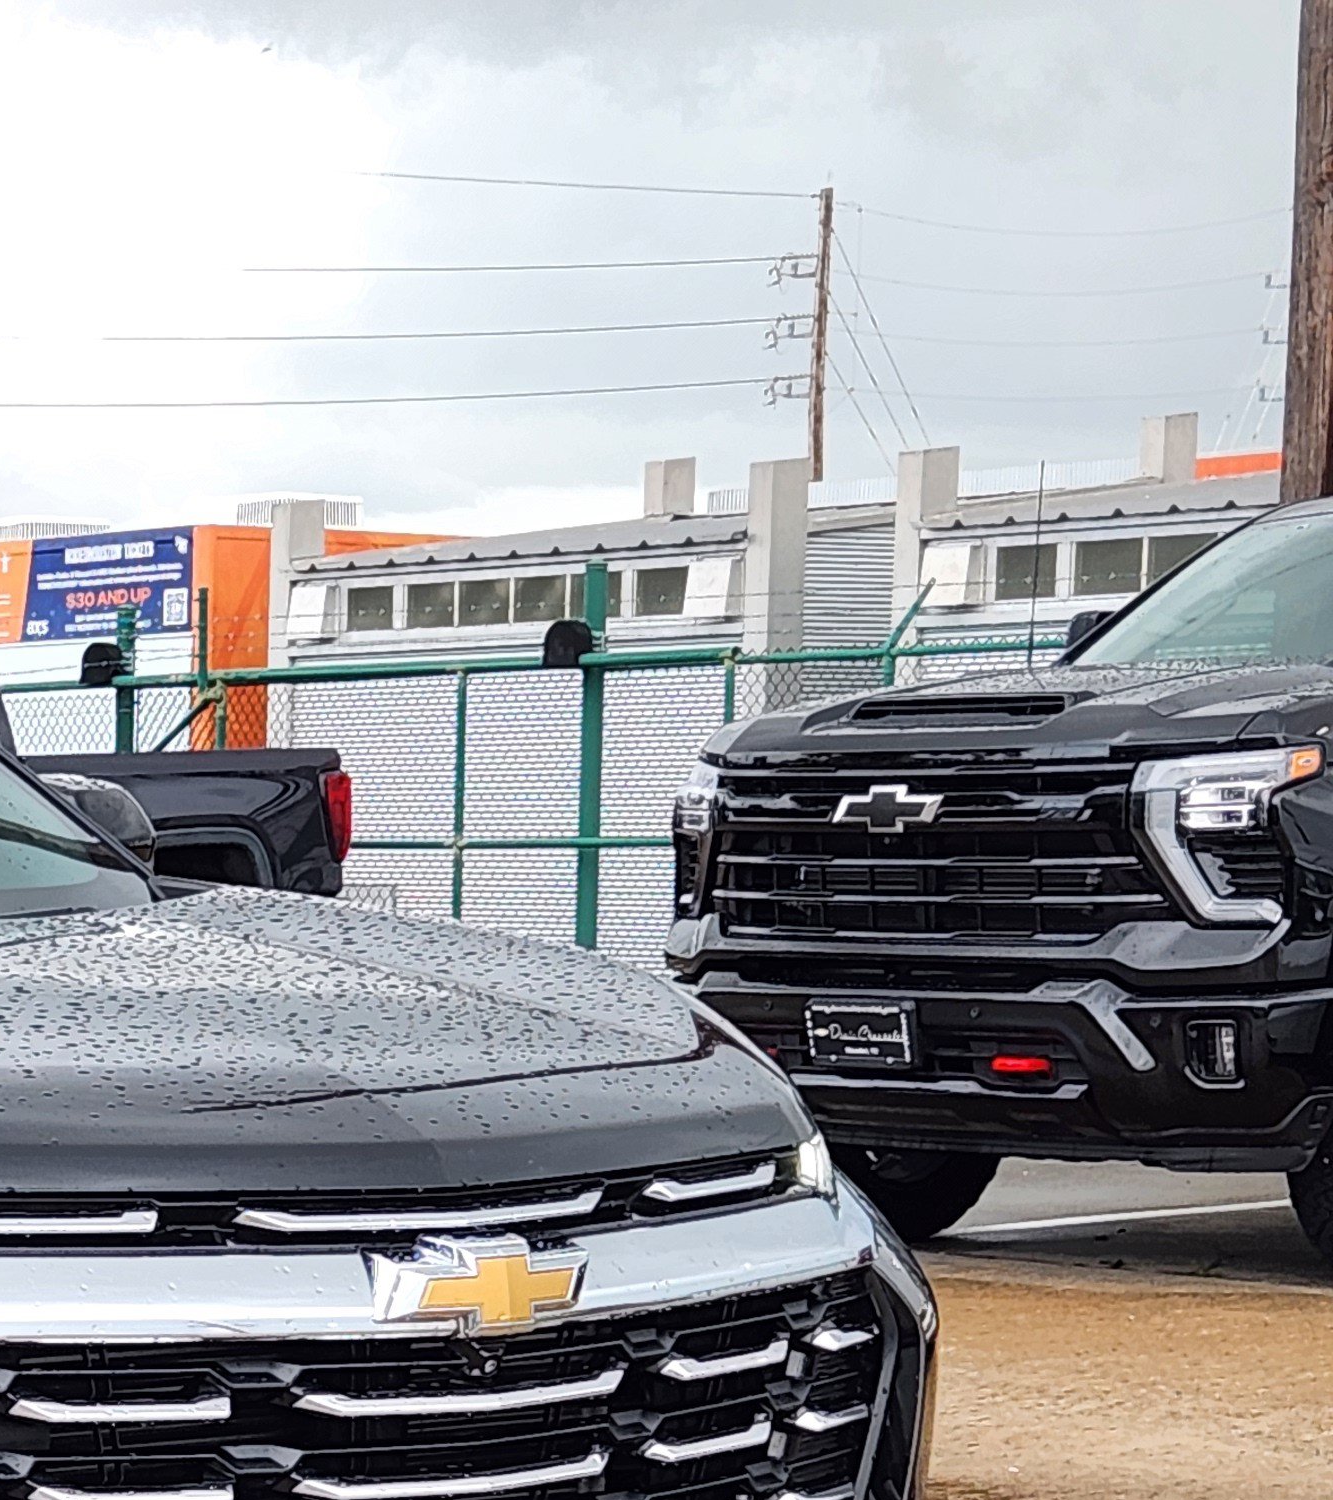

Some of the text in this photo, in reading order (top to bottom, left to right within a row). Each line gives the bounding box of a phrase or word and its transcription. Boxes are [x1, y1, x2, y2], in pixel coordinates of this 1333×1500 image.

[65, 586, 152, 609] $30 AND UP
